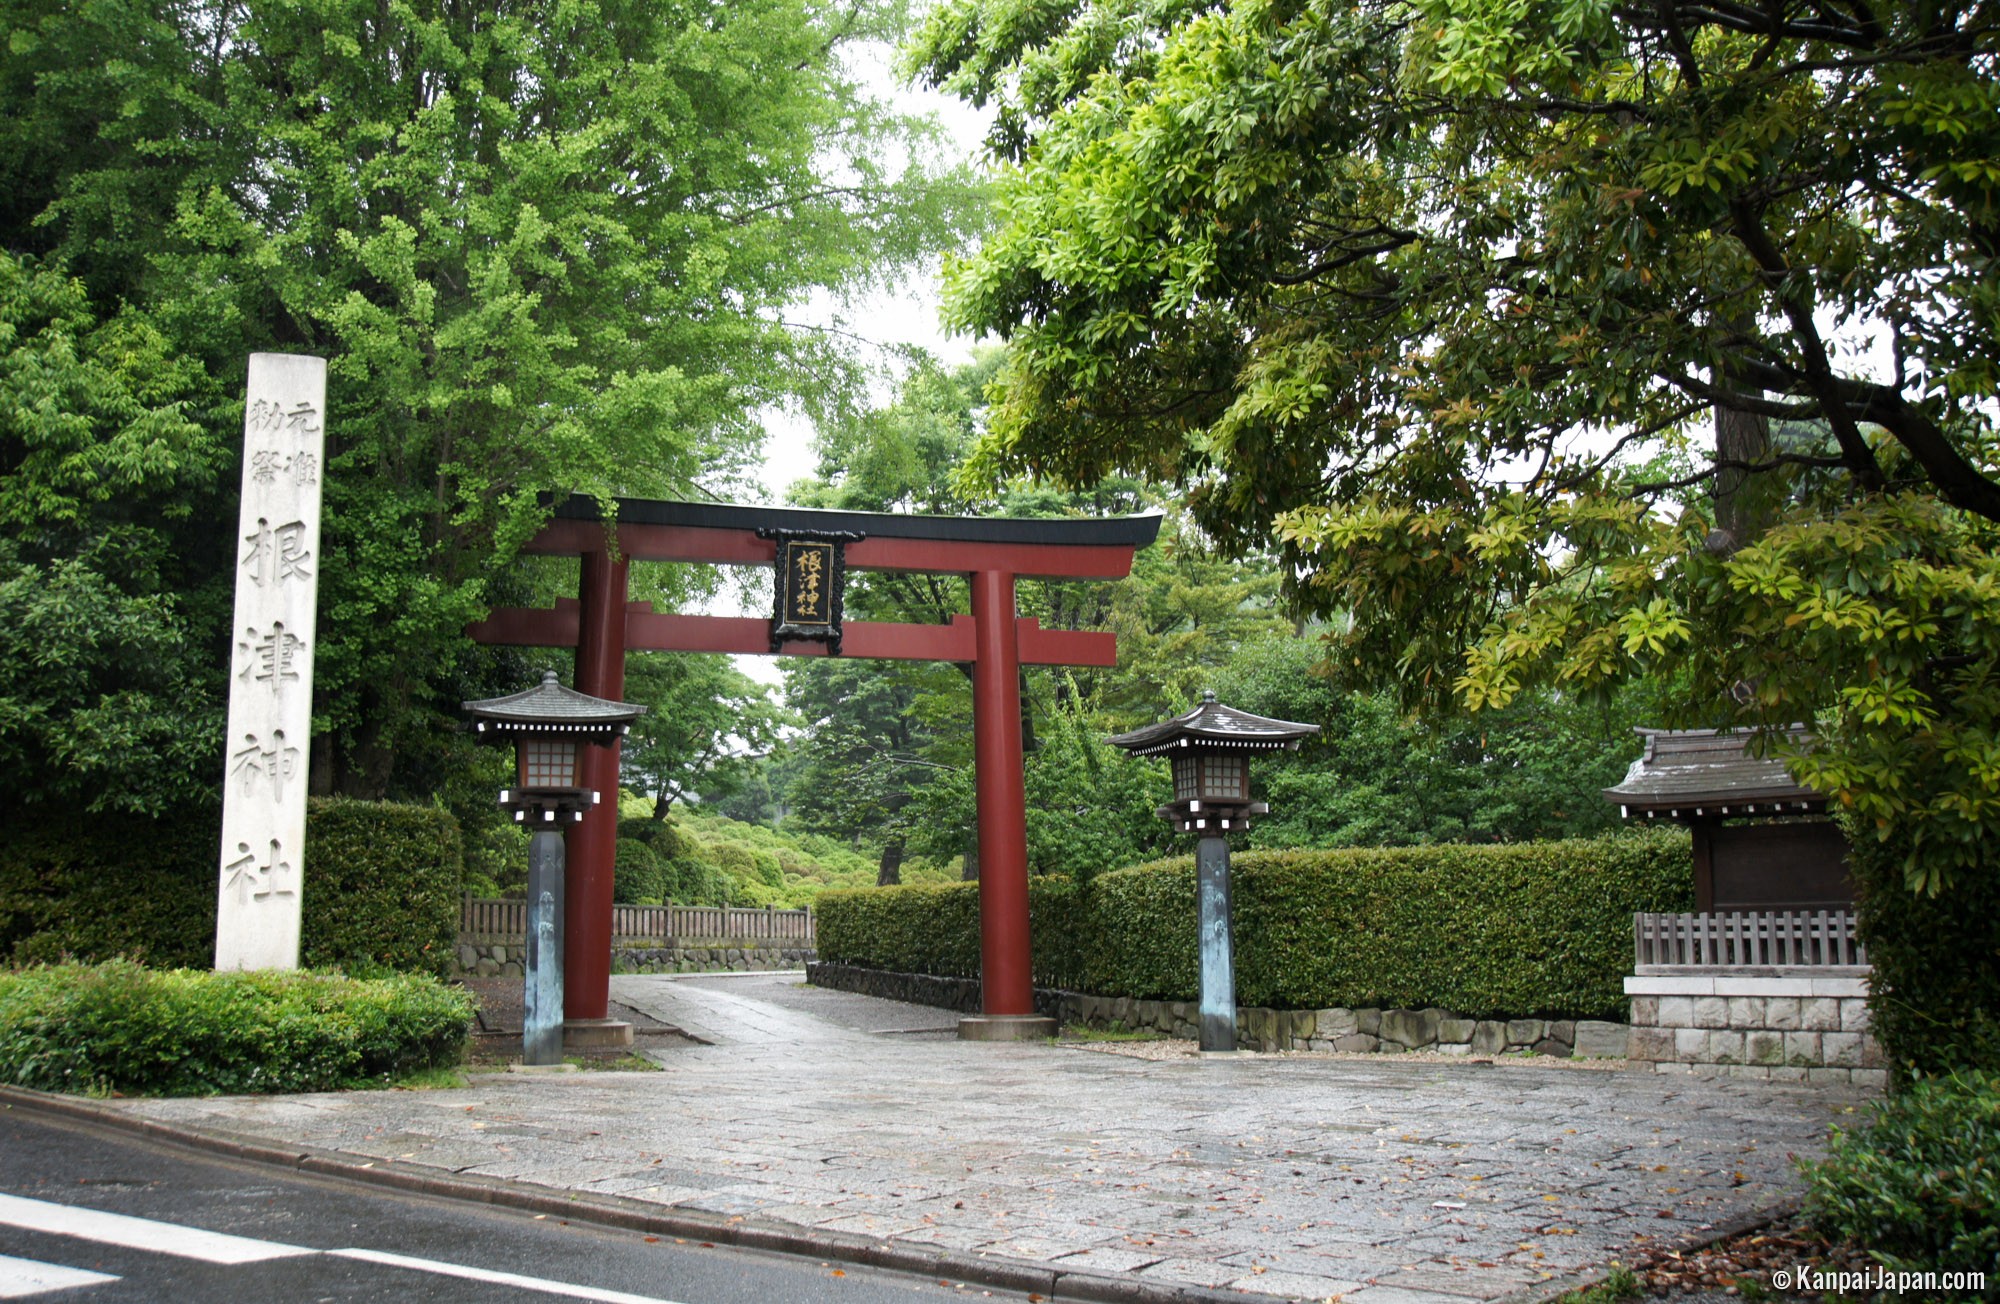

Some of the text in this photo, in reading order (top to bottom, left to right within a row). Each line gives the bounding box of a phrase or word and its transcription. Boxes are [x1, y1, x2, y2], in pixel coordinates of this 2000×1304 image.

[796, 550, 822, 616] 根津神社
[225, 516, 312, 905] 根津神社
